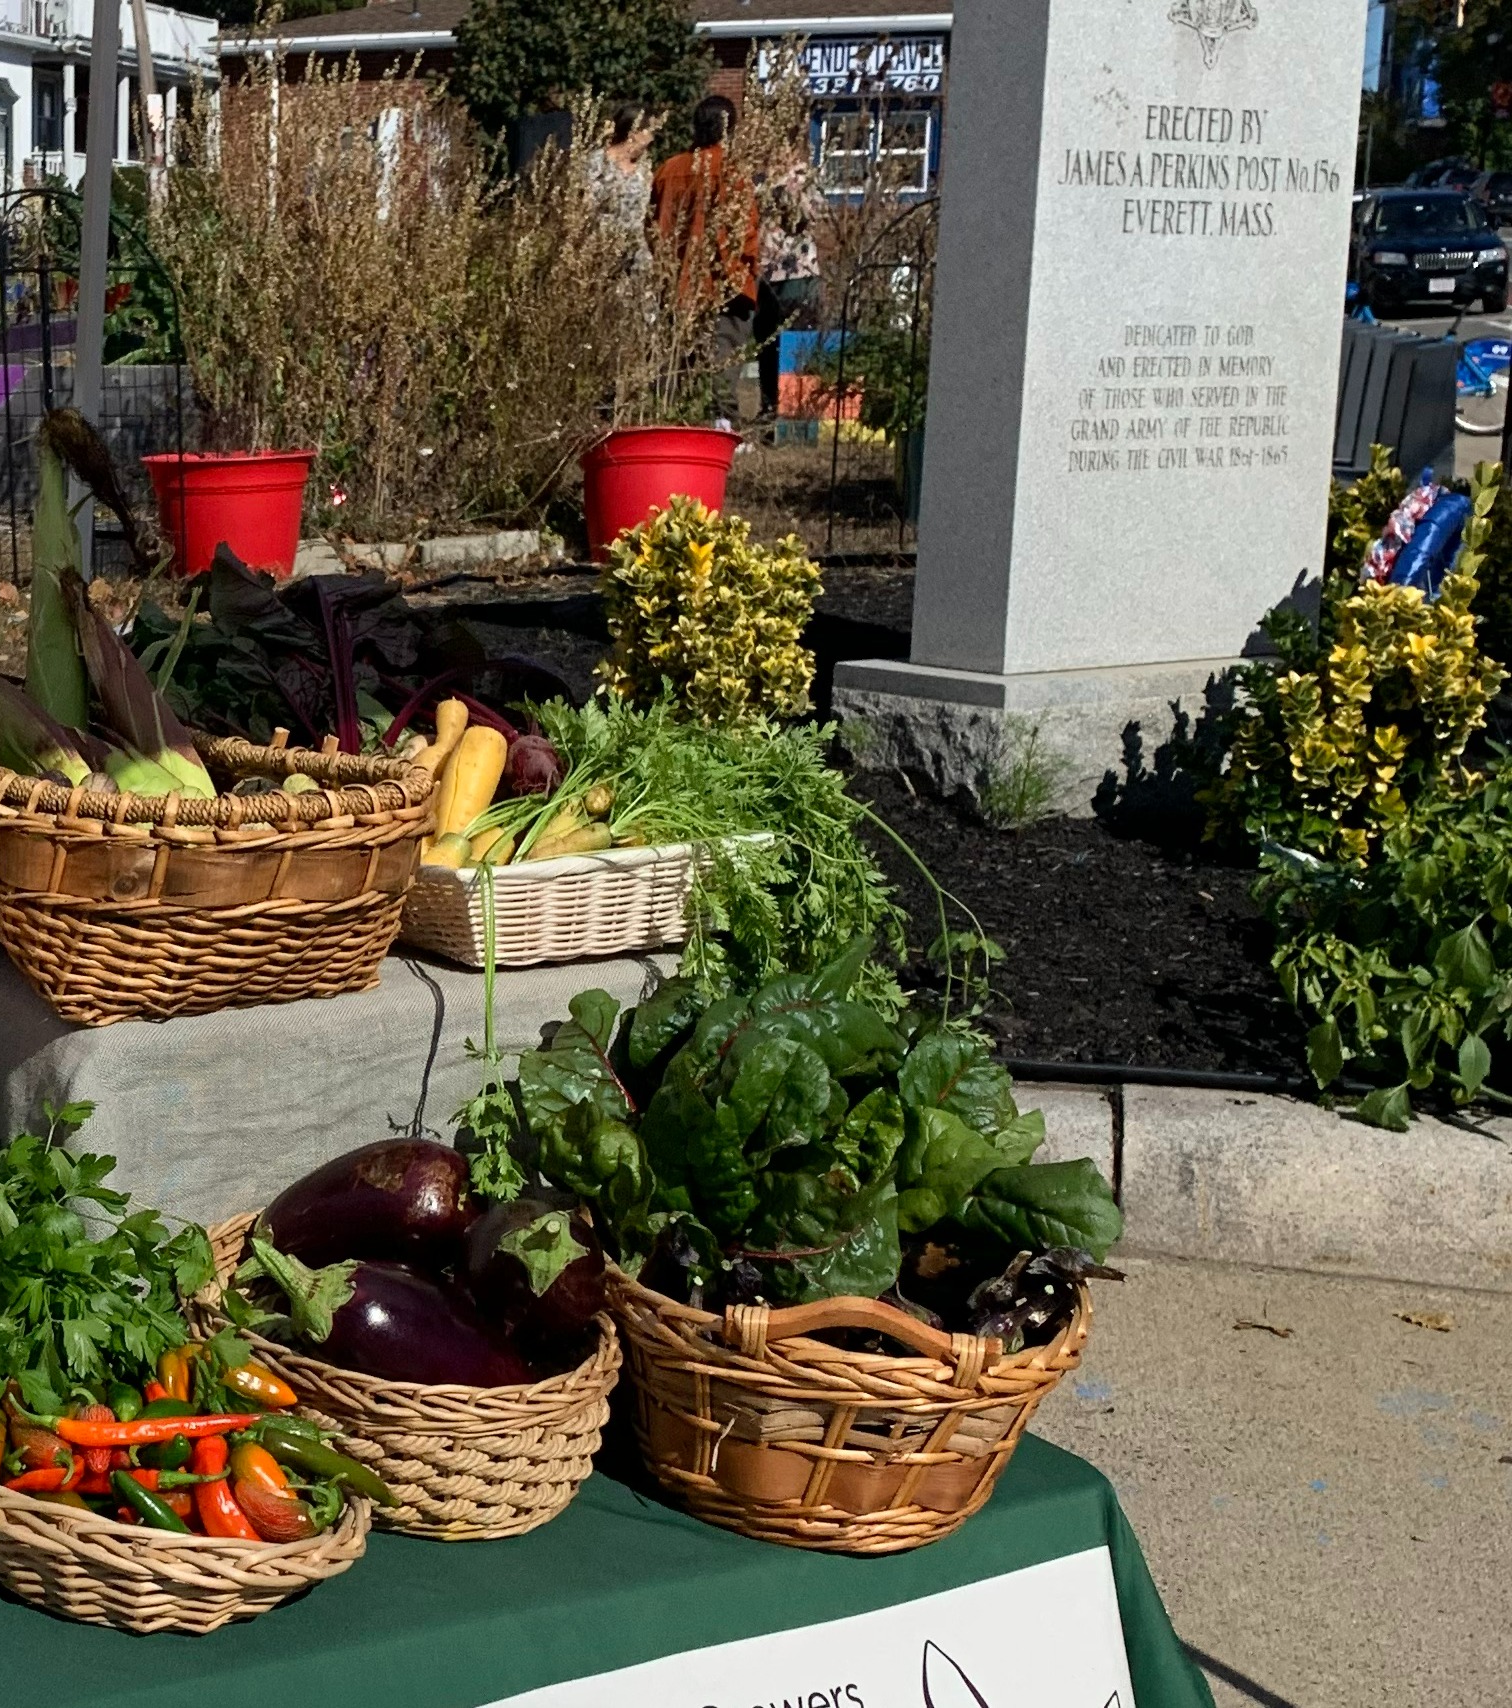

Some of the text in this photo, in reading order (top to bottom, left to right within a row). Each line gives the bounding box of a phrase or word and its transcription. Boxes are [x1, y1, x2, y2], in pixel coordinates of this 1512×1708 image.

[797, 42, 867, 73] ENDE
[1145, 105, 1269, 145] ERECTED BY
[1058, 149, 1127, 187] JAMES
[1150, 153, 1230, 190] PERKINS
[1236, 155, 1282, 193] POST
[1219, 202, 1277, 237] MASS.
[1124, 324, 1197, 347] DEDICATED
[1204, 325, 1221, 347] TO
[1097, 355, 1276, 378] AND ERECTED IN MEMORY
[1078, 385, 1288, 410] OF THOSE WHO SERVED IN THE
[1071, 415, 1290, 440] GRAND ARMY OF THE REPUBLIC
[1068, 449, 1120, 472] DURING
[1128, 448, 1149, 470] THE
[1158, 448, 1187, 469] CIVIL
[1195, 447, 1224, 468] WAR
